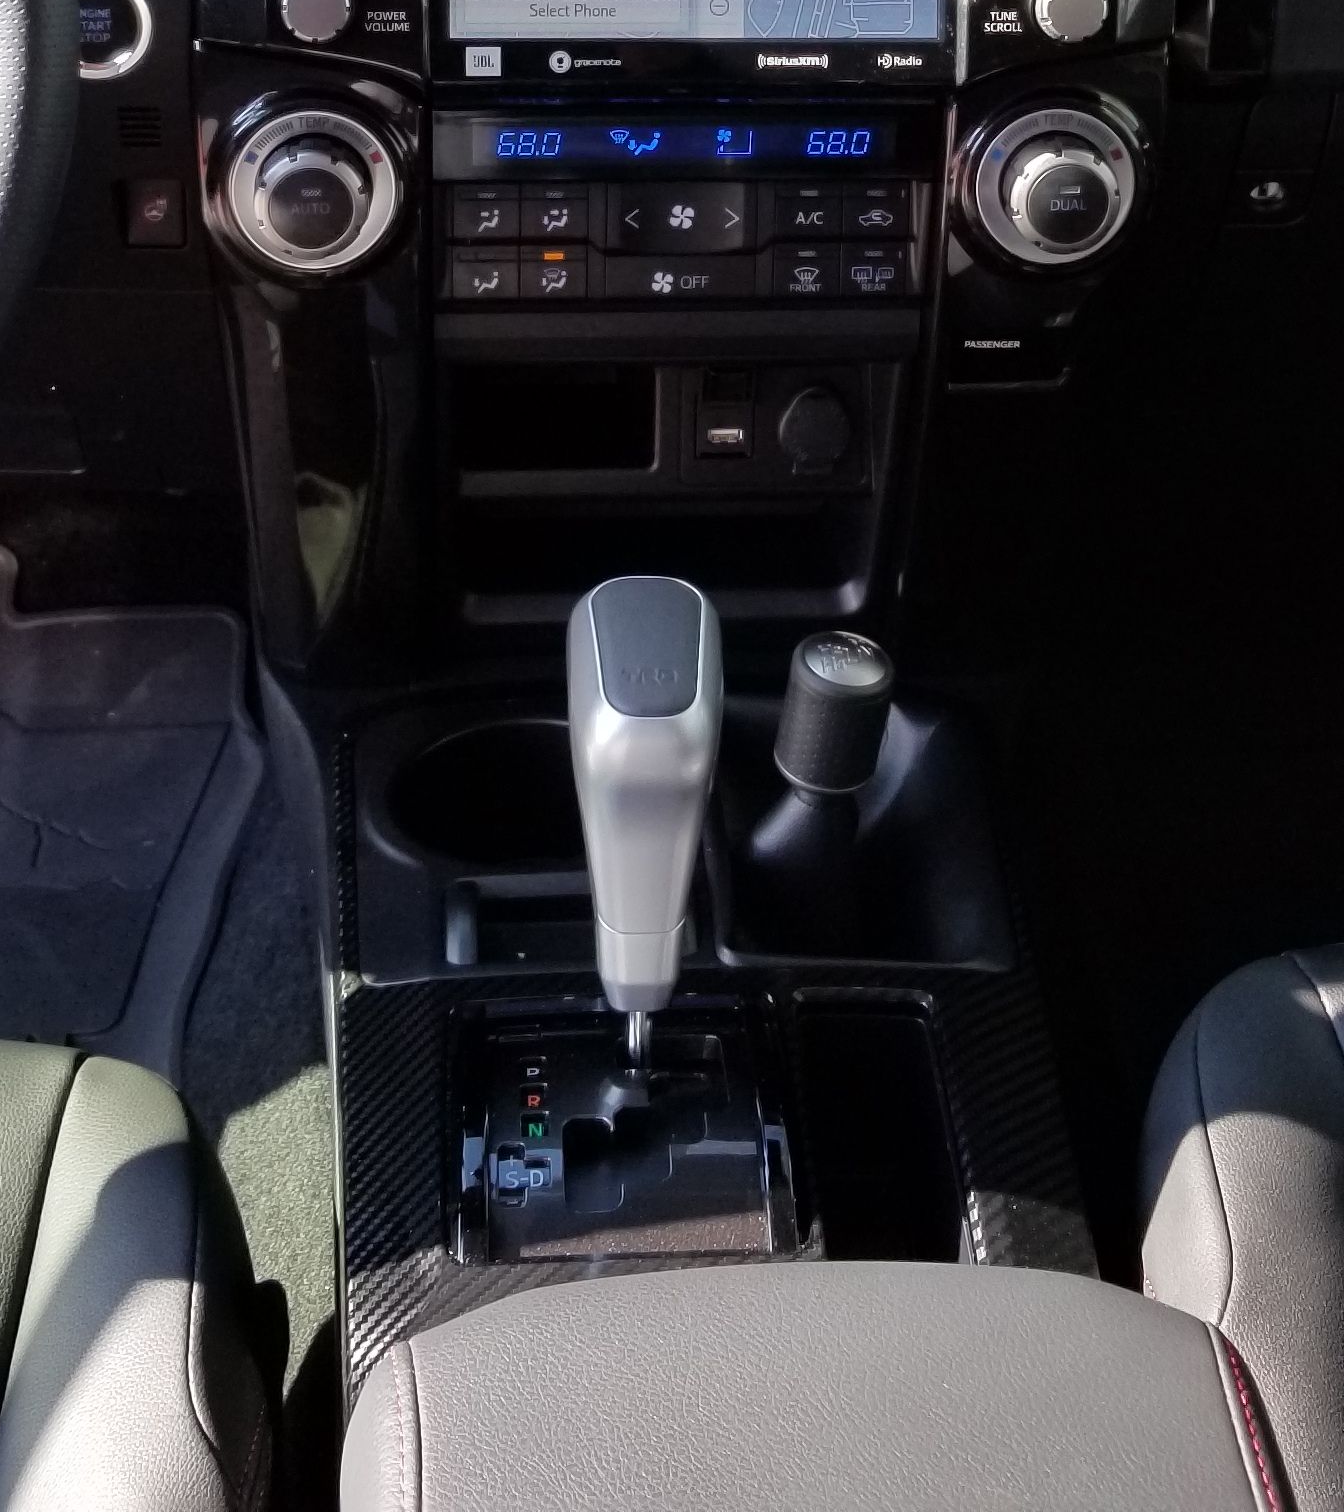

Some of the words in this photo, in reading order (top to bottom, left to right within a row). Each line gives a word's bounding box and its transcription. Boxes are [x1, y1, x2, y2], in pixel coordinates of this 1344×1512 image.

[80, 8, 111, 19] NGINE
[367, 11, 406, 21] POWER
[529, 3, 570, 17] Select
[574, 3, 617, 17] Phone
[990, 11, 1018, 21] TUNE
[80, 21, 112, 31] TART
[364, 22, 410, 33] VOLUME
[984, 22, 1023, 33] SCROLL
[473, 55, 495, 68] JBL
[574, 58, 622, 67] gracenote
[893, 56, 923, 66] Radio
[297, 116, 330, 130] TEMP
[496, 131, 561, 157] 68.0
[807, 131, 870, 155] 68.0
[291, 202, 331, 215] AUTO
[1050, 199, 1087, 212] DUAL
[795, 211, 824, 226] A/C
[680, 275, 710, 289] OFF
[789, 283, 822, 292] FRONT
[861, 282, 886, 292] REAR
[964, 340, 1021, 349] PASSENGER
[527, 1094, 541, 1108] R
[528, 1123, 543, 1137] N
